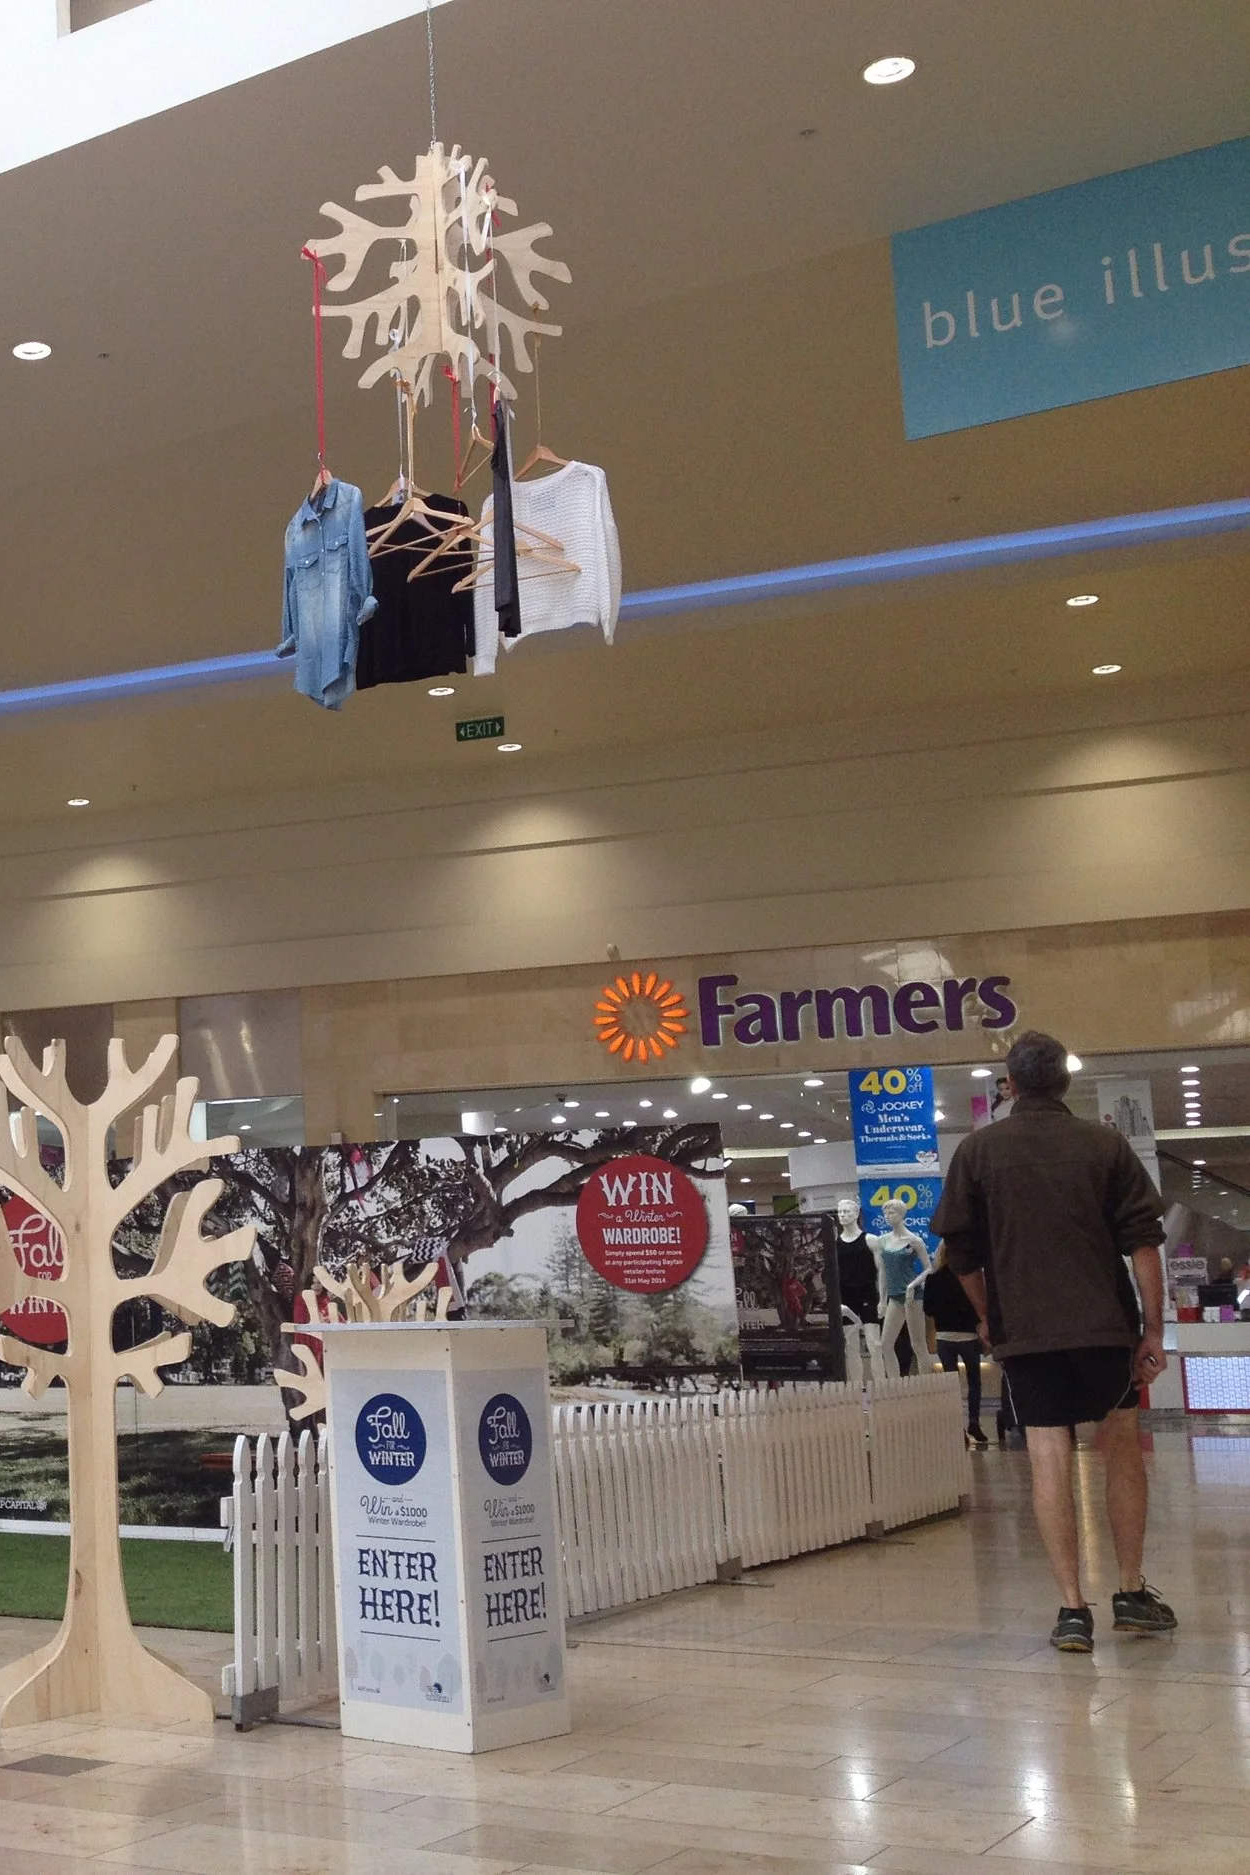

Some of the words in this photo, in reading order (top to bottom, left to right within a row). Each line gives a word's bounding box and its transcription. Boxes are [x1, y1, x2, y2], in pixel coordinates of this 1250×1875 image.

[922, 283, 1064, 348] blue
[467, 722, 493, 737] EXIT
[698, 974, 1018, 1047] Farmers
[907, 1082, 922, 1093] off
[878, 1101, 924, 1111] JOCKEY
[878, 1114, 909, 1123] Men's
[599, 1171, 674, 1206] WIN
[625, 1209, 665, 1222] Winter
[603, 1227, 681, 1244] WARDROBE!
[1170, 1258, 1205, 1270] essie
[366, 1406, 410, 1443] Fall
[487, 1406, 520, 1444] Fall
[368, 1451, 415, 1467] WINTER
[489, 1450, 525, 1468] WINTER
[360, 1496, 393, 1517] Win
[401, 1507, 427, 1518] $1000
[484, 1499, 509, 1519] Win
[515, 1504, 535, 1517] $1000
[368, 1516, 389, 1525] Winter
[391, 1518, 426, 1528] Wardrobe!
[491, 1519, 507, 1528] Winter
[358, 1548, 438, 1583] ENTER
[483, 1546, 544, 1583] ENTER
[359, 1585, 441, 1628] HERE!
[486, 1582, 547, 1629] HERE!
